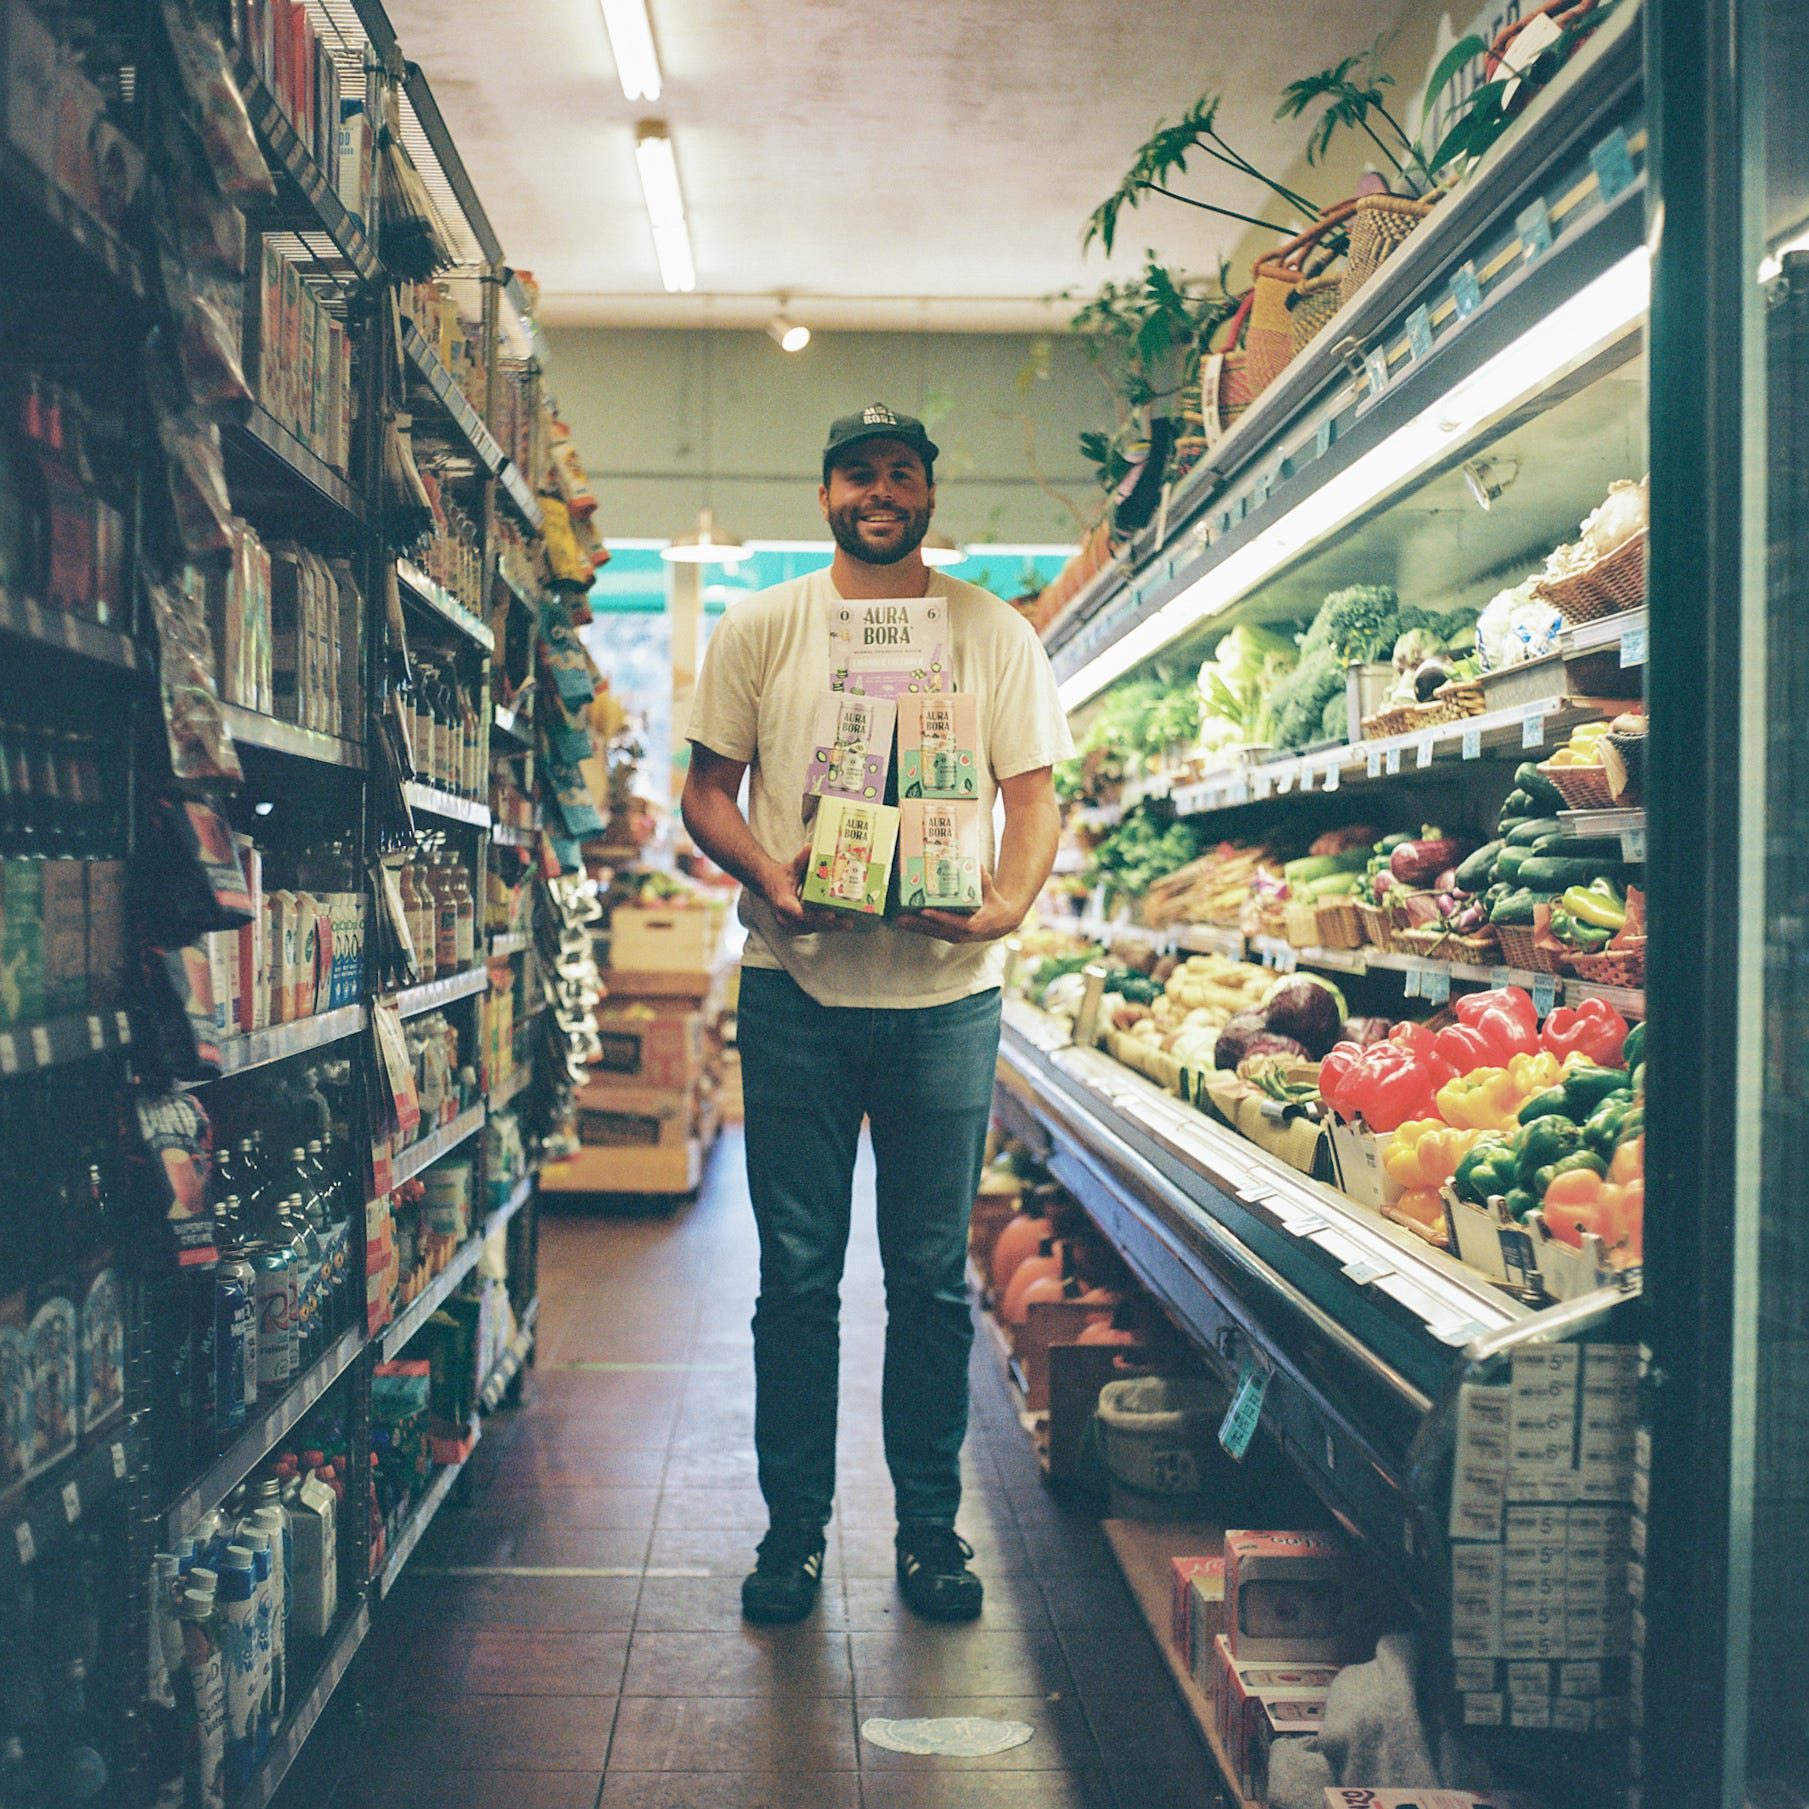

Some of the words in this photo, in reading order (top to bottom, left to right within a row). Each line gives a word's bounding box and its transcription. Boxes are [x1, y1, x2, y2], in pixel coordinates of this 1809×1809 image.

[863, 414, 897, 425] BORA
[864, 606, 909, 625] AURA
[927, 608, 936, 620] 6
[864, 626, 911, 645] BORA
[843, 712, 866, 724] AURA
[926, 711, 949, 721] AURA
[842, 722, 866, 734] BORA
[926, 721, 950, 731] BORA
[846, 818, 869, 831] AURA
[928, 817, 952, 827] AURA
[844, 828, 868, 841] BORA
[928, 827, 952, 838] BORA
